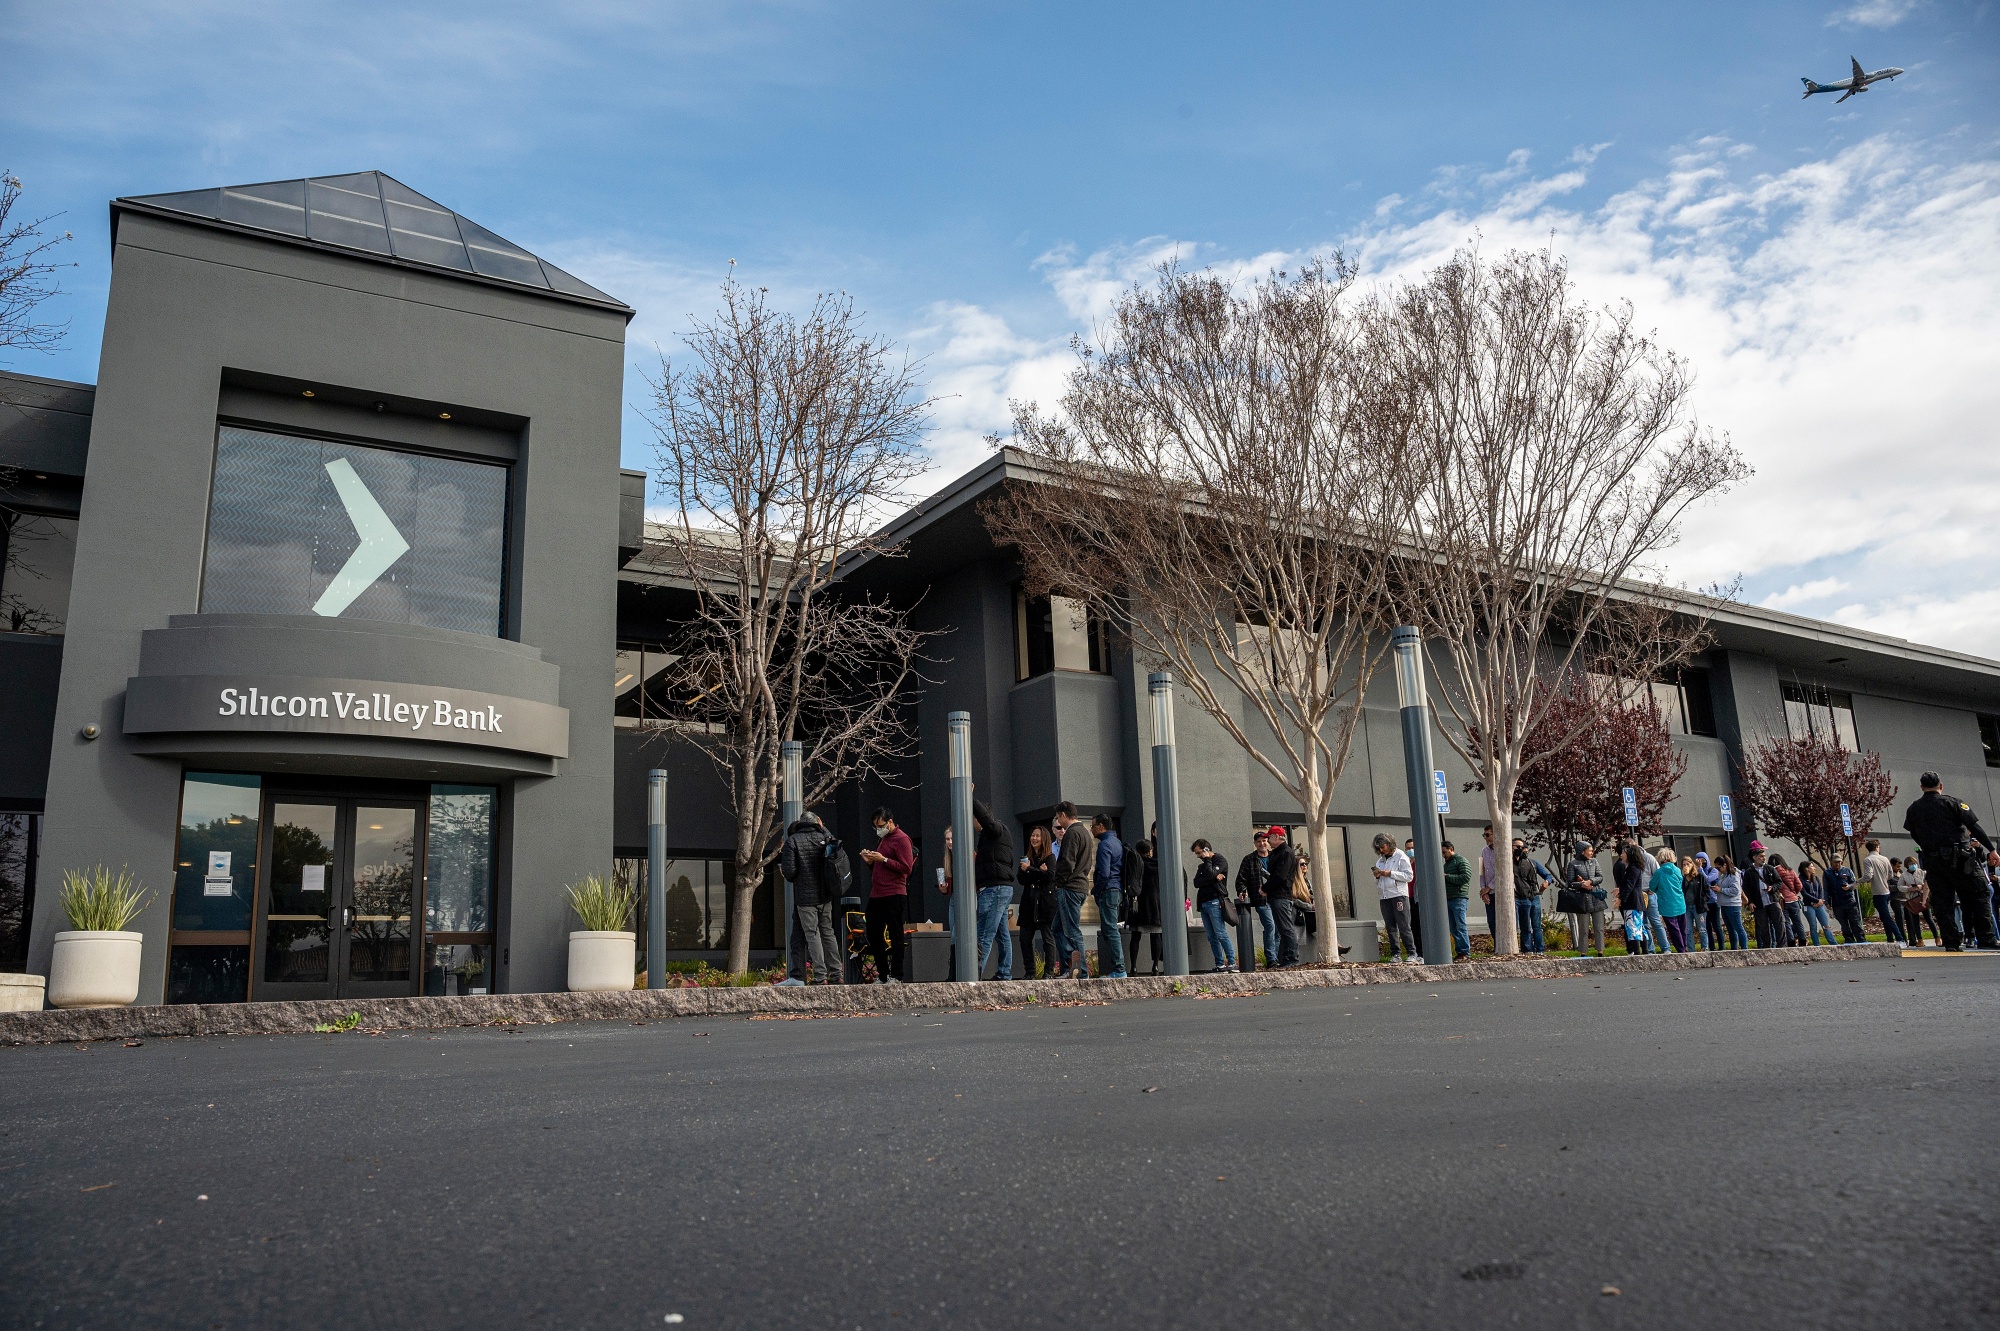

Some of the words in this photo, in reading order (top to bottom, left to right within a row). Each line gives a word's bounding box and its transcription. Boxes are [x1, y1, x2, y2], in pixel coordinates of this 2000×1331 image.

[218, 687, 329, 717] Silicon
[331, 691, 429, 730] Valley
[432, 699, 503, 733] Bank
[363, 860, 394, 876] svb
